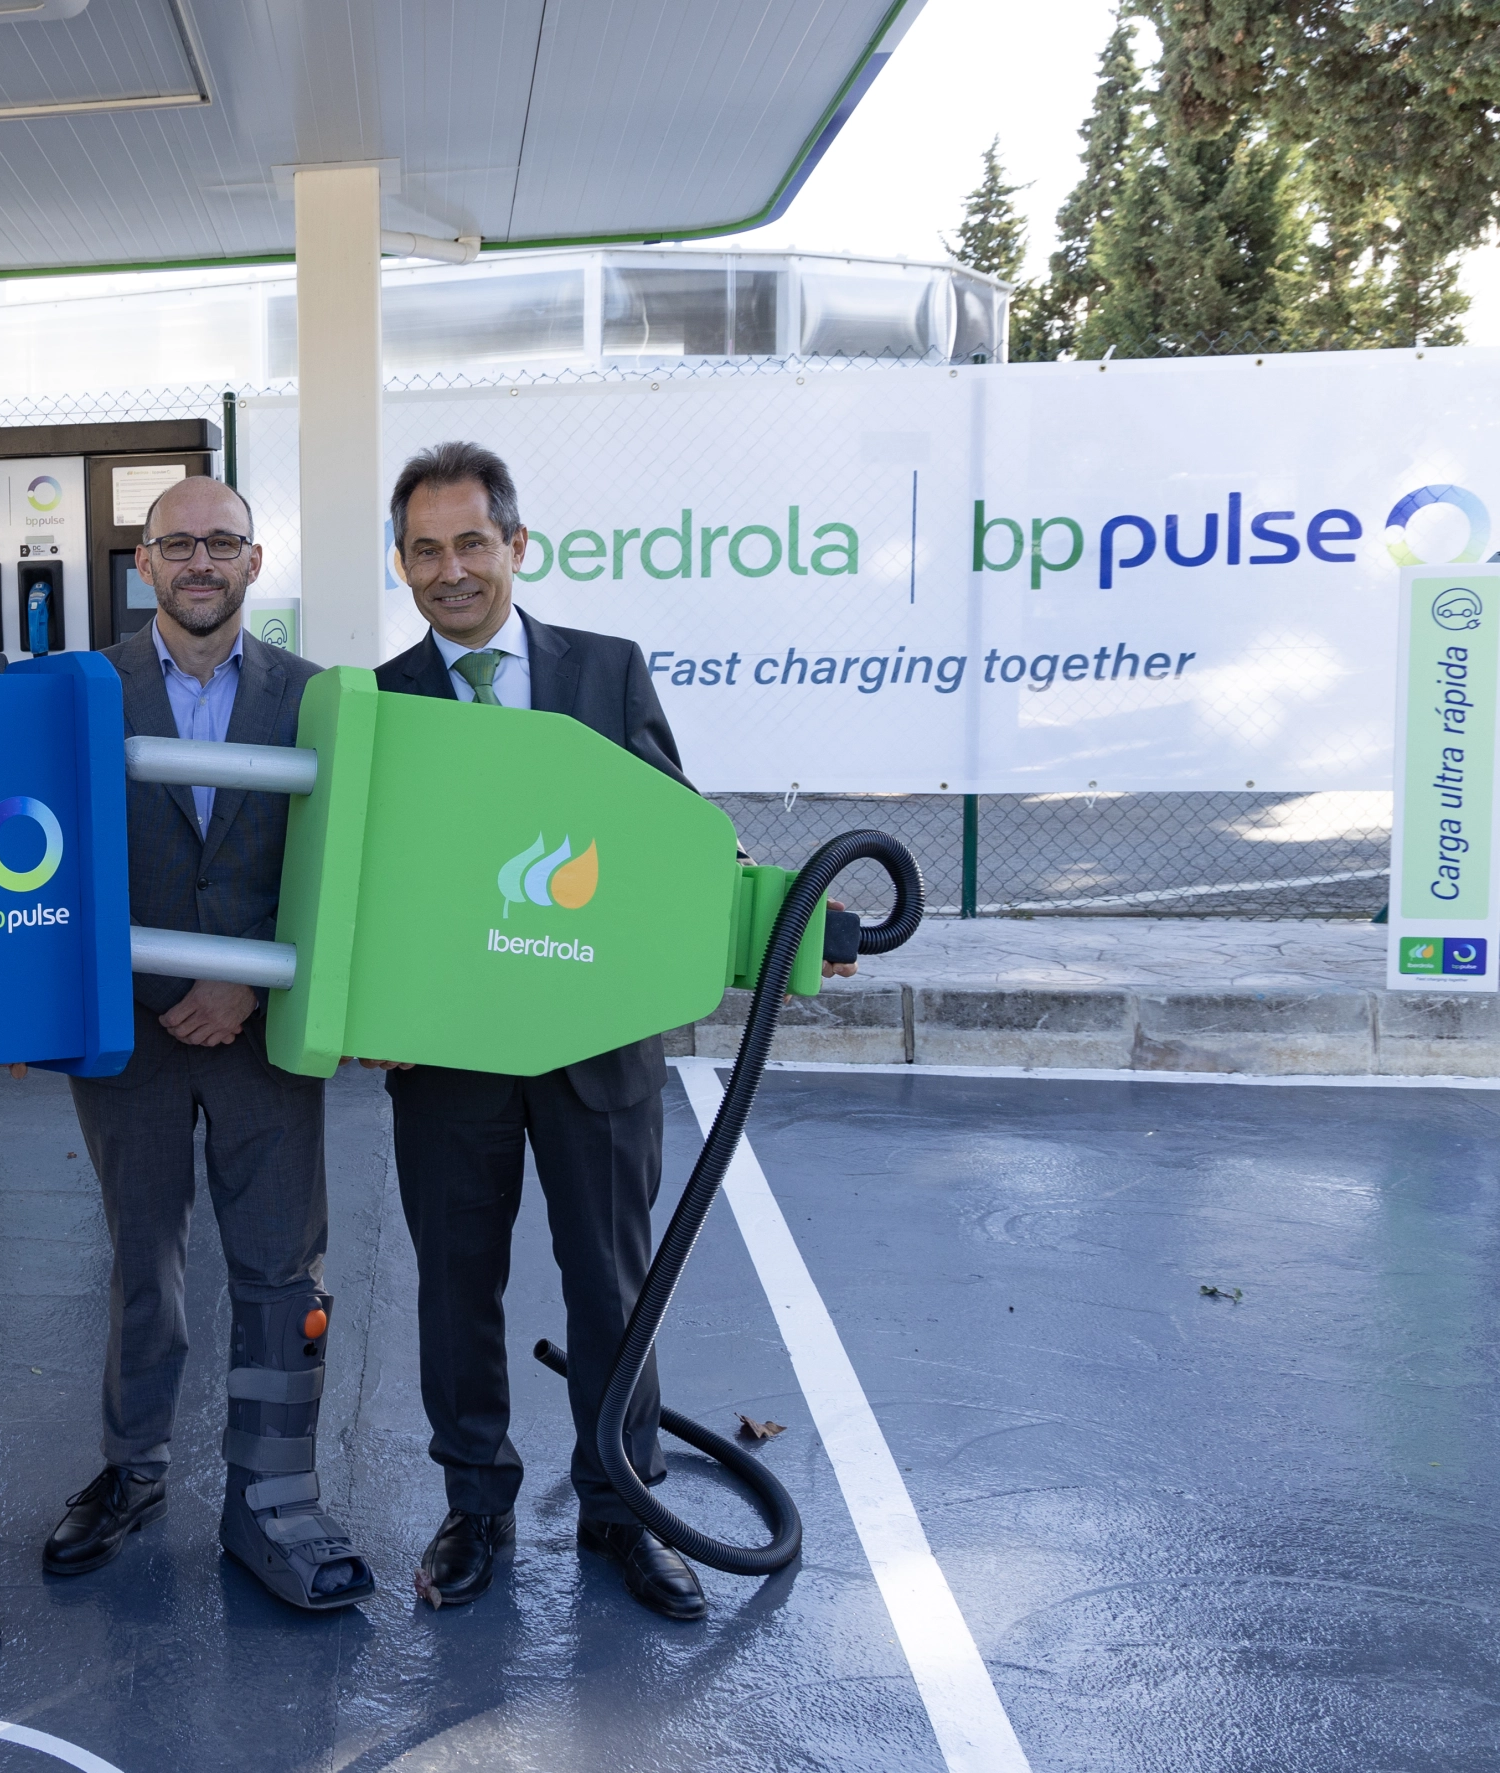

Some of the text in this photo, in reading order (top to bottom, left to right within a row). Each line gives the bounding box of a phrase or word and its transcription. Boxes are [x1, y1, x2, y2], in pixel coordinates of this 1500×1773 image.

[21, 547, 27, 555] 2
[512, 505, 860, 583] erdrola
[649, 642, 1197, 694] Fast charging together
[1430, 646, 1475, 901] Carga ultra rápida
[487, 928, 595, 963] Iberdrola
